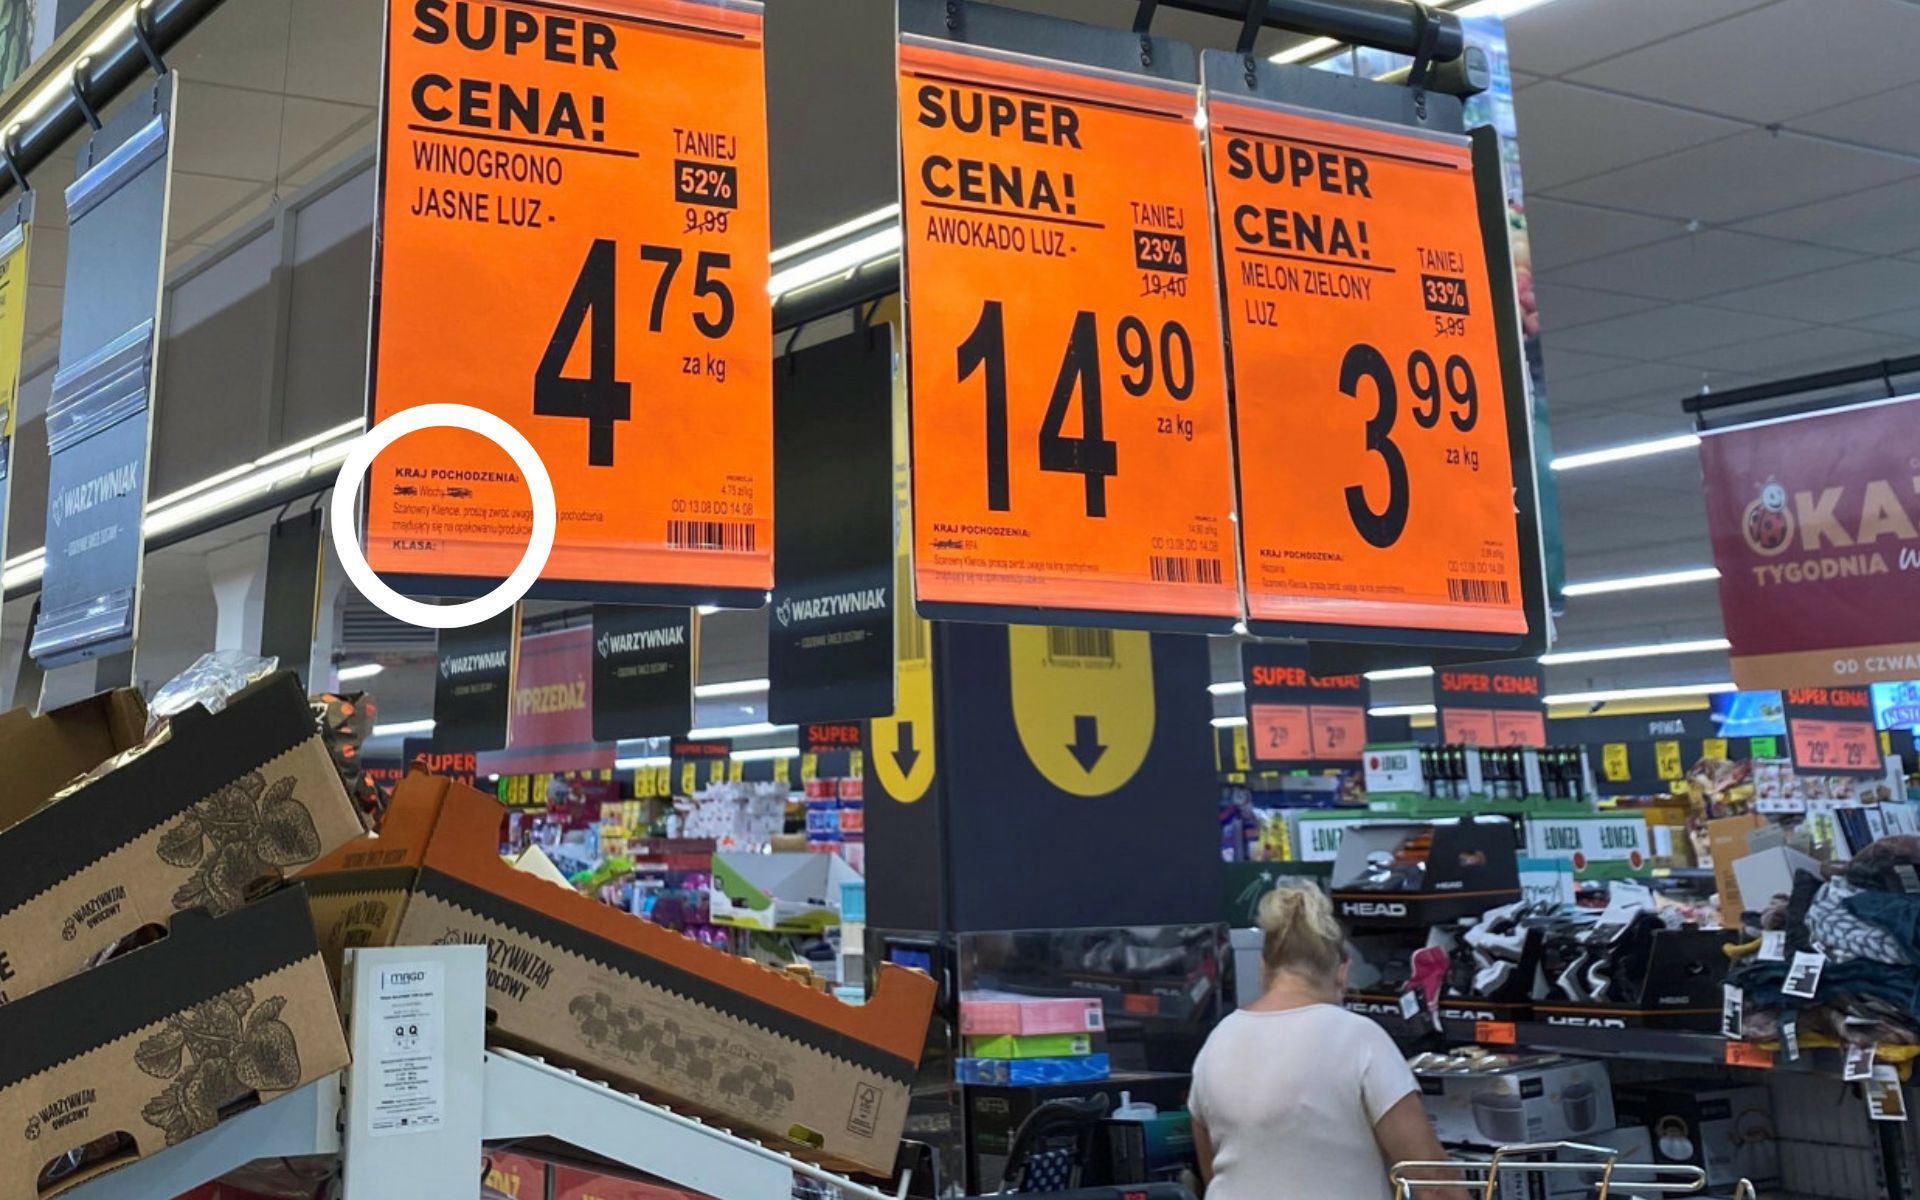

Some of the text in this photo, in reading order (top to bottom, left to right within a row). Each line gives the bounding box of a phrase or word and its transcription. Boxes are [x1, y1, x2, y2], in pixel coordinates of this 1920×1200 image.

[412, 0, 618, 70] SUPER
[411, 74, 605, 142] CENA!
[918, 85, 1082, 149] SUPER
[673, 129, 737, 160] TANIEJ
[413, 140, 562, 186] WINOGRONO
[1227, 138, 1372, 198] SUPER
[680, 167, 731, 198] 52%
[921, 155, 1076, 215] CENA!
[411, 187, 489, 223] JASNE
[498, 198, 541, 228] LUZ
[1130, 202, 1184, 229] TANIEJ
[927, 216, 1025, 252] AWOKADO
[1031, 228, 1066, 257] LUZ
[1234, 205, 1370, 260] CENA!
[1139, 236, 1182, 266] 23%
[1417, 248, 1464, 273] TANIEJ
[1241, 261, 1371, 301] MELON ZIELONY
[1425, 280, 1464, 308] 33%
[1246, 299, 1278, 326] LUZ
[682, 353, 726, 382] za kg
[1157, 415, 1193, 441] za kg
[1446, 446, 1479, 471] za kg
[395, 467, 520, 483] KRAJ POCHODZENIA:
[65, 460, 138, 519] WARZYWNIAK
[672, 499, 686, 513] OD
[934, 523, 1031, 538] KRAJ POCHODZENIA:
[393, 540, 436, 550] KLASA:
[1260, 549, 1281, 559] KRAJ
[1753, 552, 1888, 587] TYGODNIA
[791, 588, 885, 621] WARZYWNIAK
[610, 626, 684, 653] WARZYWNIAK
[451, 650, 507, 674] WARZYWNIAK
[1834, 654, 1920, 674] OD CZWA
[1252, 666, 1306, 688] SUPER
[1441, 672, 1538, 695] SUPER CENA!
[516, 674, 587, 716] YPRZEDAŻ
[1788, 687, 1828, 706] SUPER
[808, 724, 859, 743] SUPER
[1343, 902, 1407, 917] HEAD
